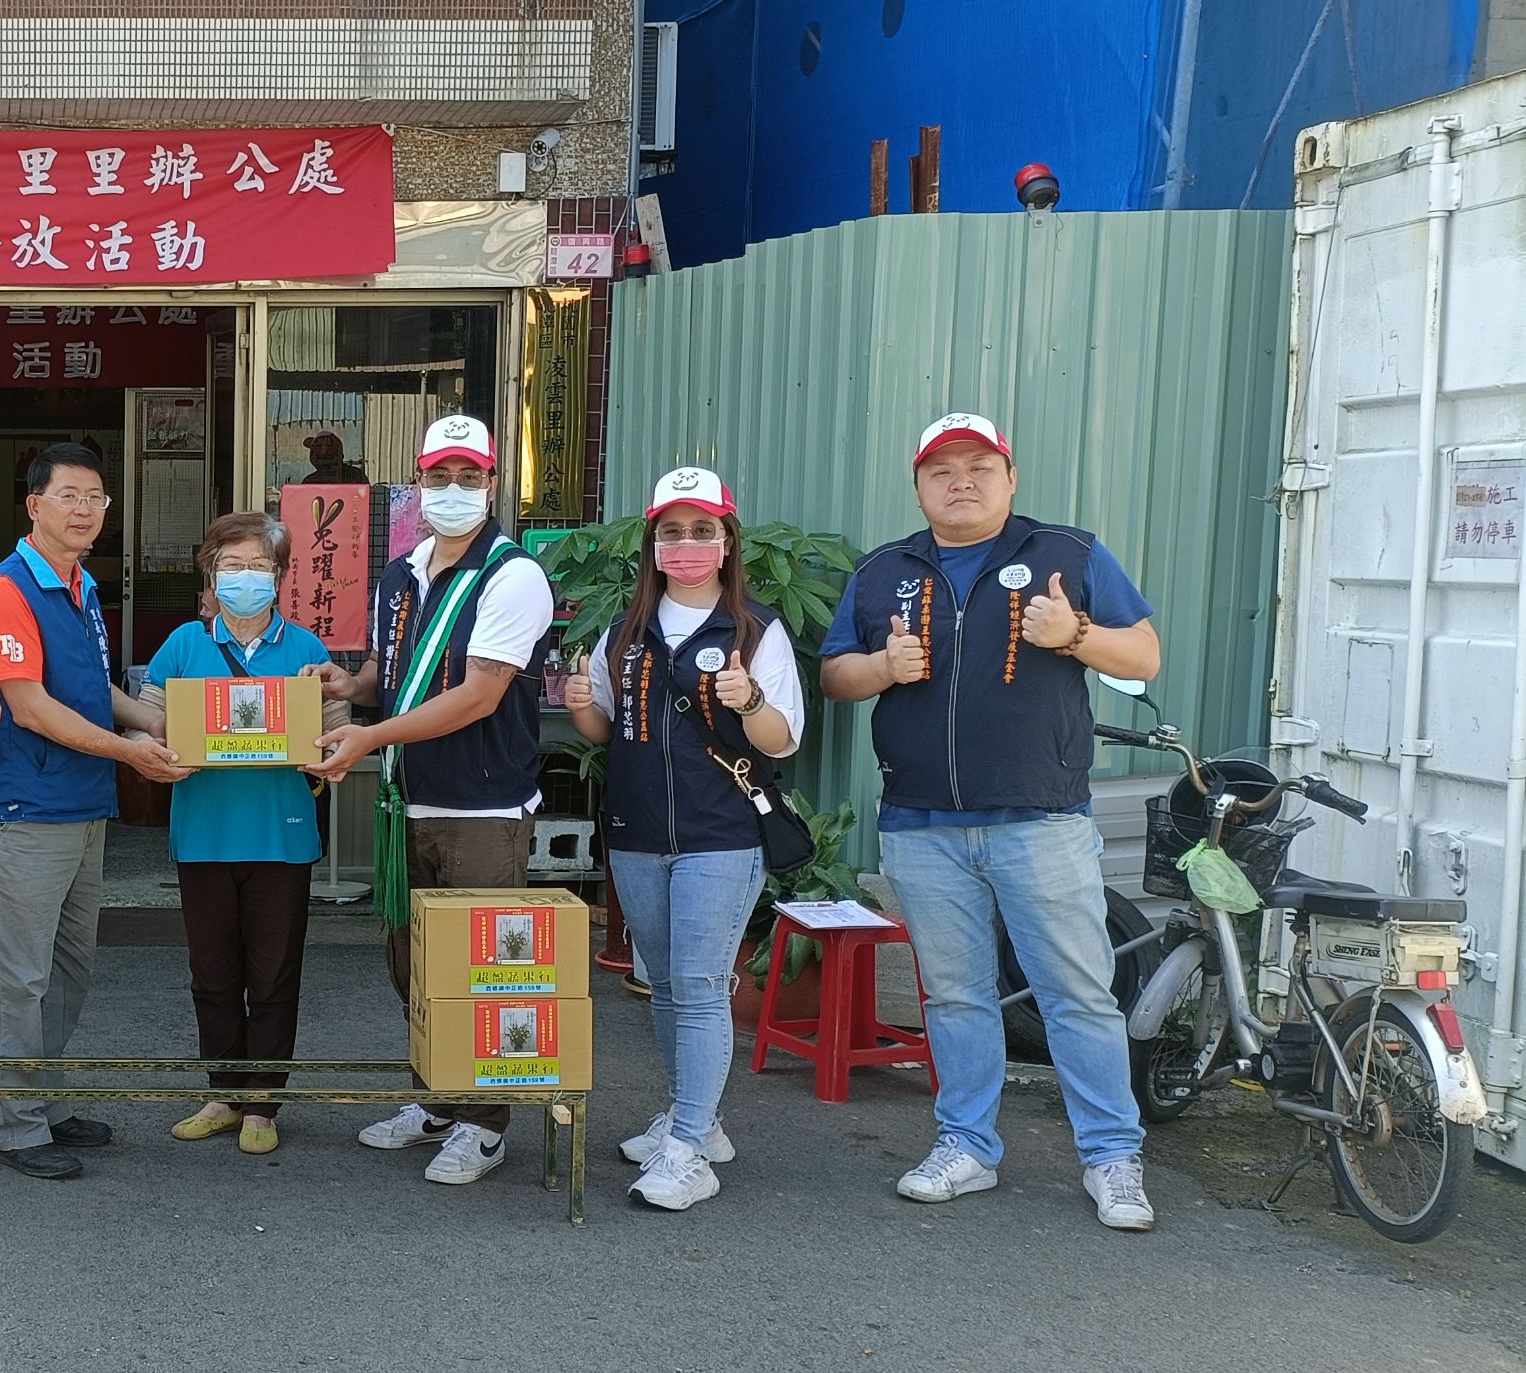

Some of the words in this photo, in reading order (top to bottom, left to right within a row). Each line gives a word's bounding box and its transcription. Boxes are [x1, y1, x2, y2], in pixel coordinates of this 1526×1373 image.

[567, 252, 600, 274] 42
[541, 354, 568, 512] 凌雲里辦公處
[1454, 519, 1517, 545] 請勿停車
